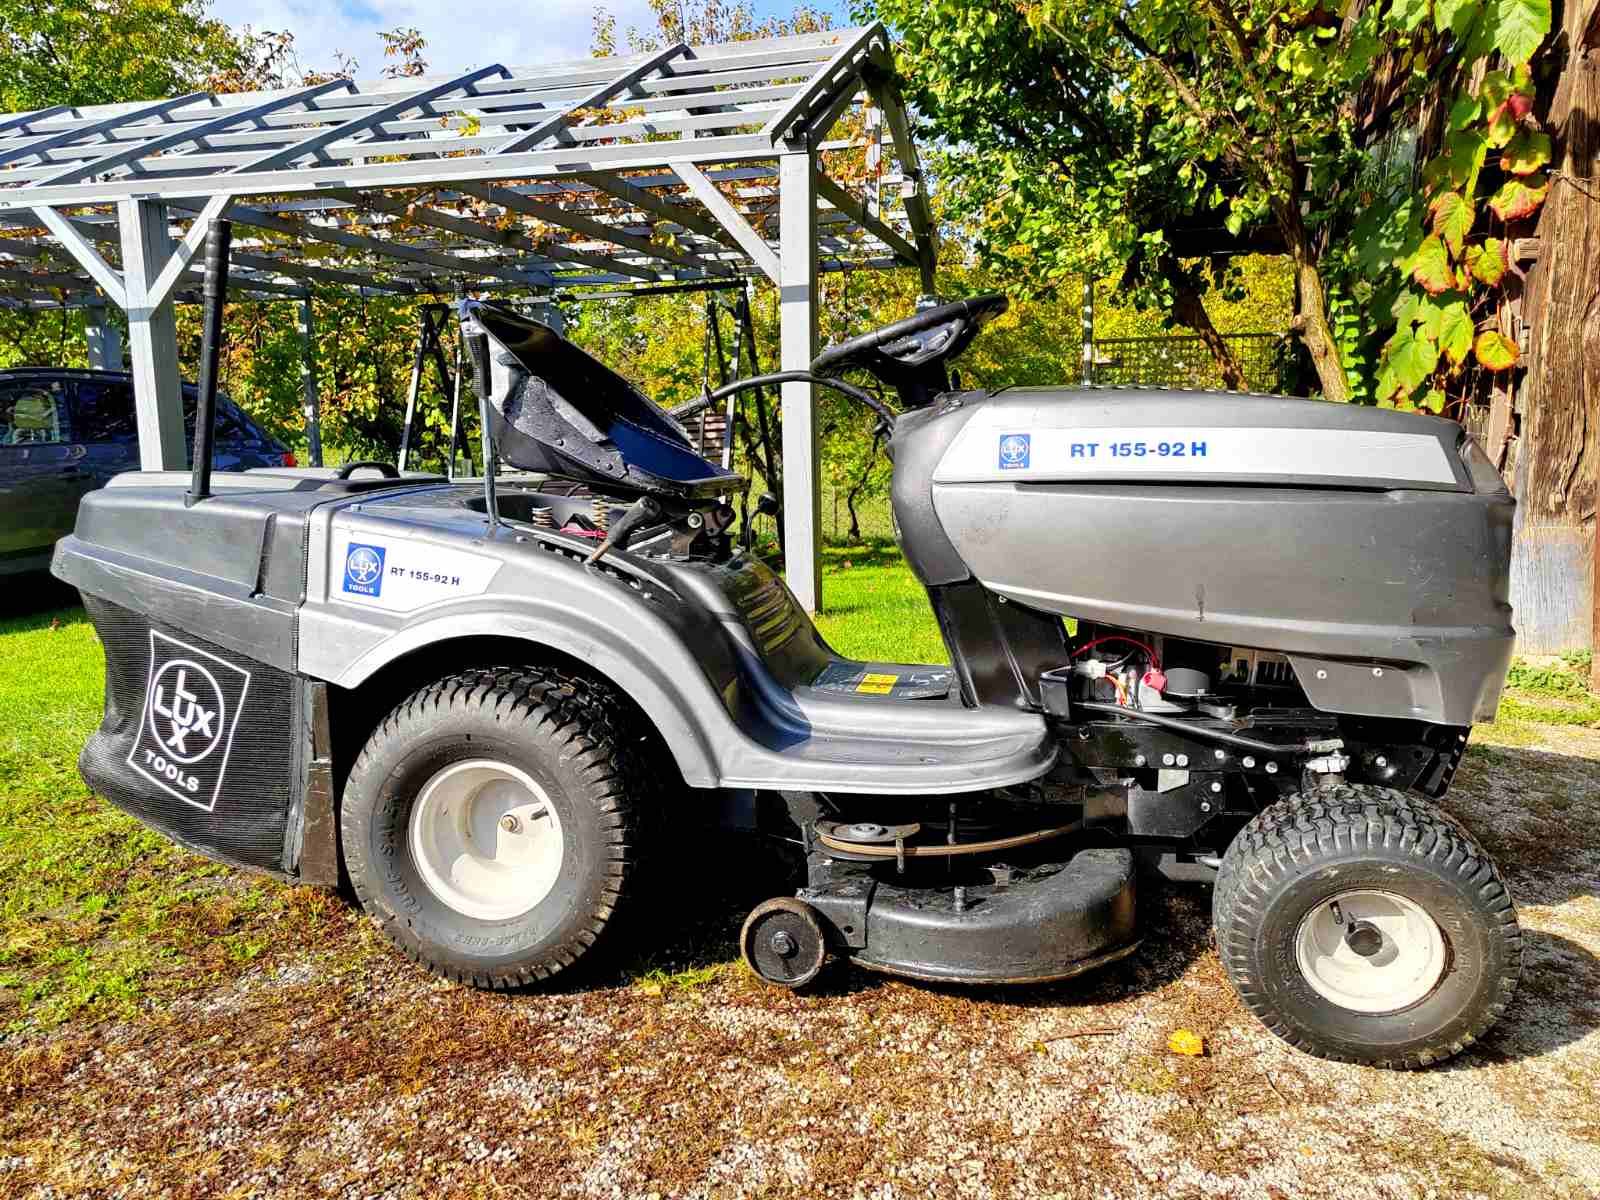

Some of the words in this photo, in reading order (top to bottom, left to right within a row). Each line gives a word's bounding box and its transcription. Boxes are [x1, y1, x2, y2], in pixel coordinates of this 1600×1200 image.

[1070, 443, 1099, 457] RT
[1109, 442, 1186, 457] 155-92
[1192, 441, 1207, 457] H
[391, 567, 405, 577] RT
[410, 570, 448, 585] 155-92
[451, 576, 460, 586] H
[348, 583, 375, 594] TOOLS
[144, 749, 199, 792] TOOLS
